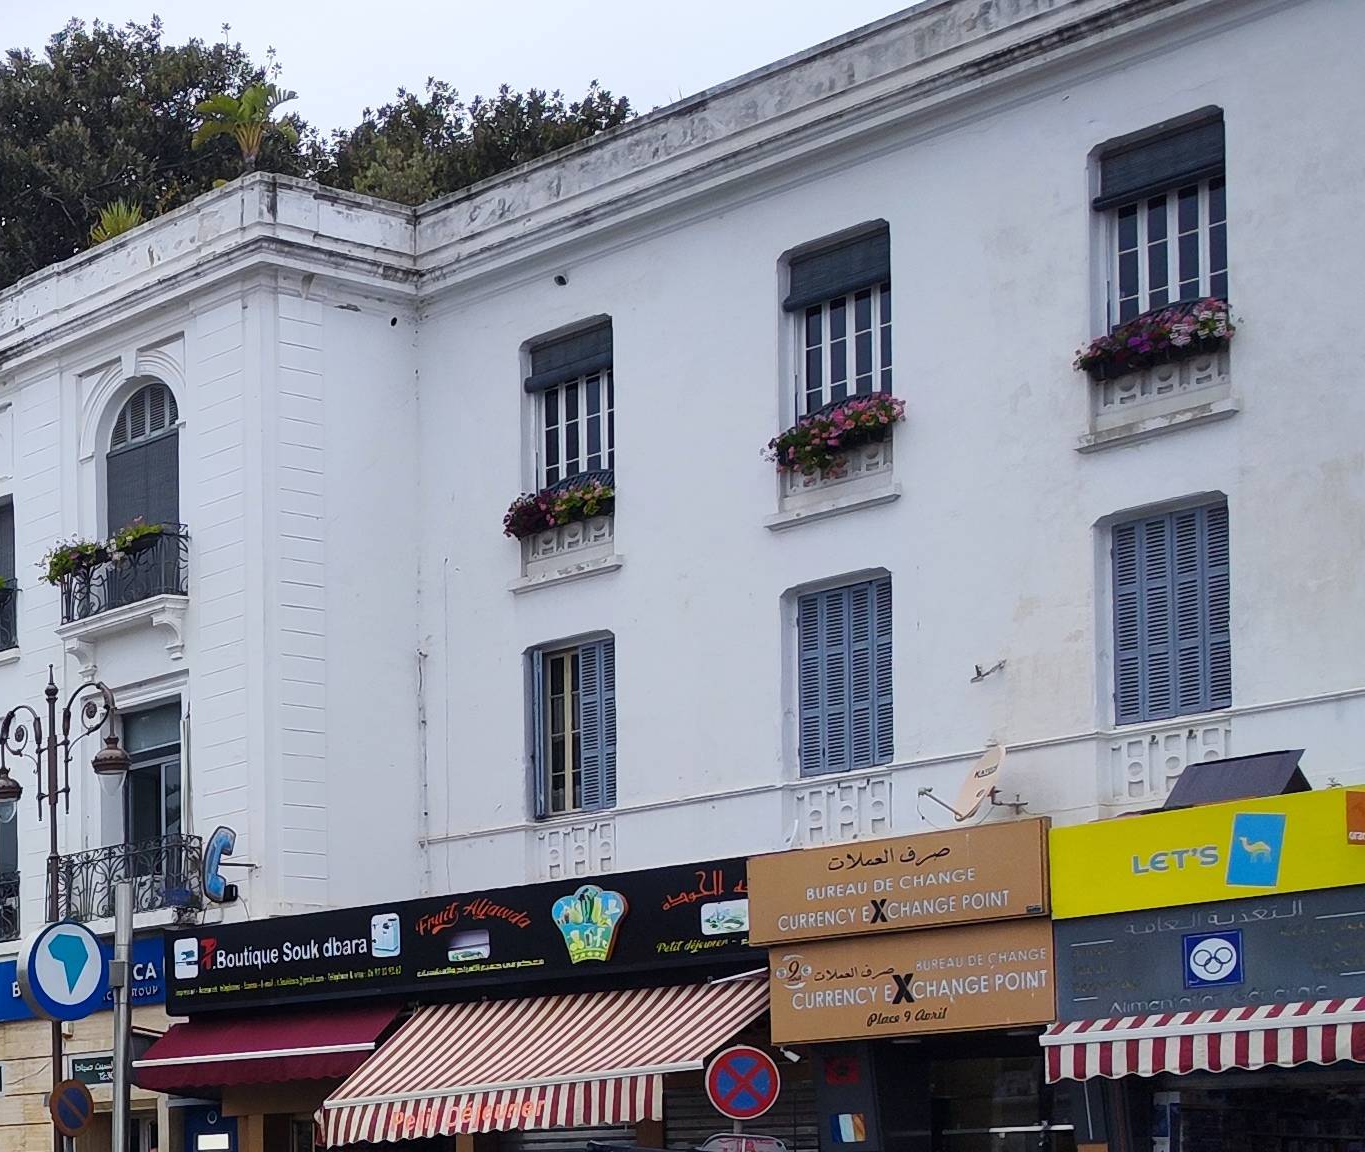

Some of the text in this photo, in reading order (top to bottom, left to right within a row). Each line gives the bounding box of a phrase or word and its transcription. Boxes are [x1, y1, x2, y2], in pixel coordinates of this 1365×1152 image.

[1131, 845, 1219, 875] LET'S
[806, 868, 975, 901] BUREAU DE CHANGE
[777, 890, 1010, 932] CURRENCY EXCHANGE POINT
[282, 939, 319, 961] Souk
[322, 936, 368, 957] dbara
[656, 941, 682, 953] Petit
[916, 948, 1047, 971] BUREAU DE CHANGE
[792, 986, 878, 1010] CURRENCY
[883, 973, 989, 1005] EXCHANGE
[995, 969, 1048, 991] POINT
[867, 1007, 949, 1027] Place 9 Avril
